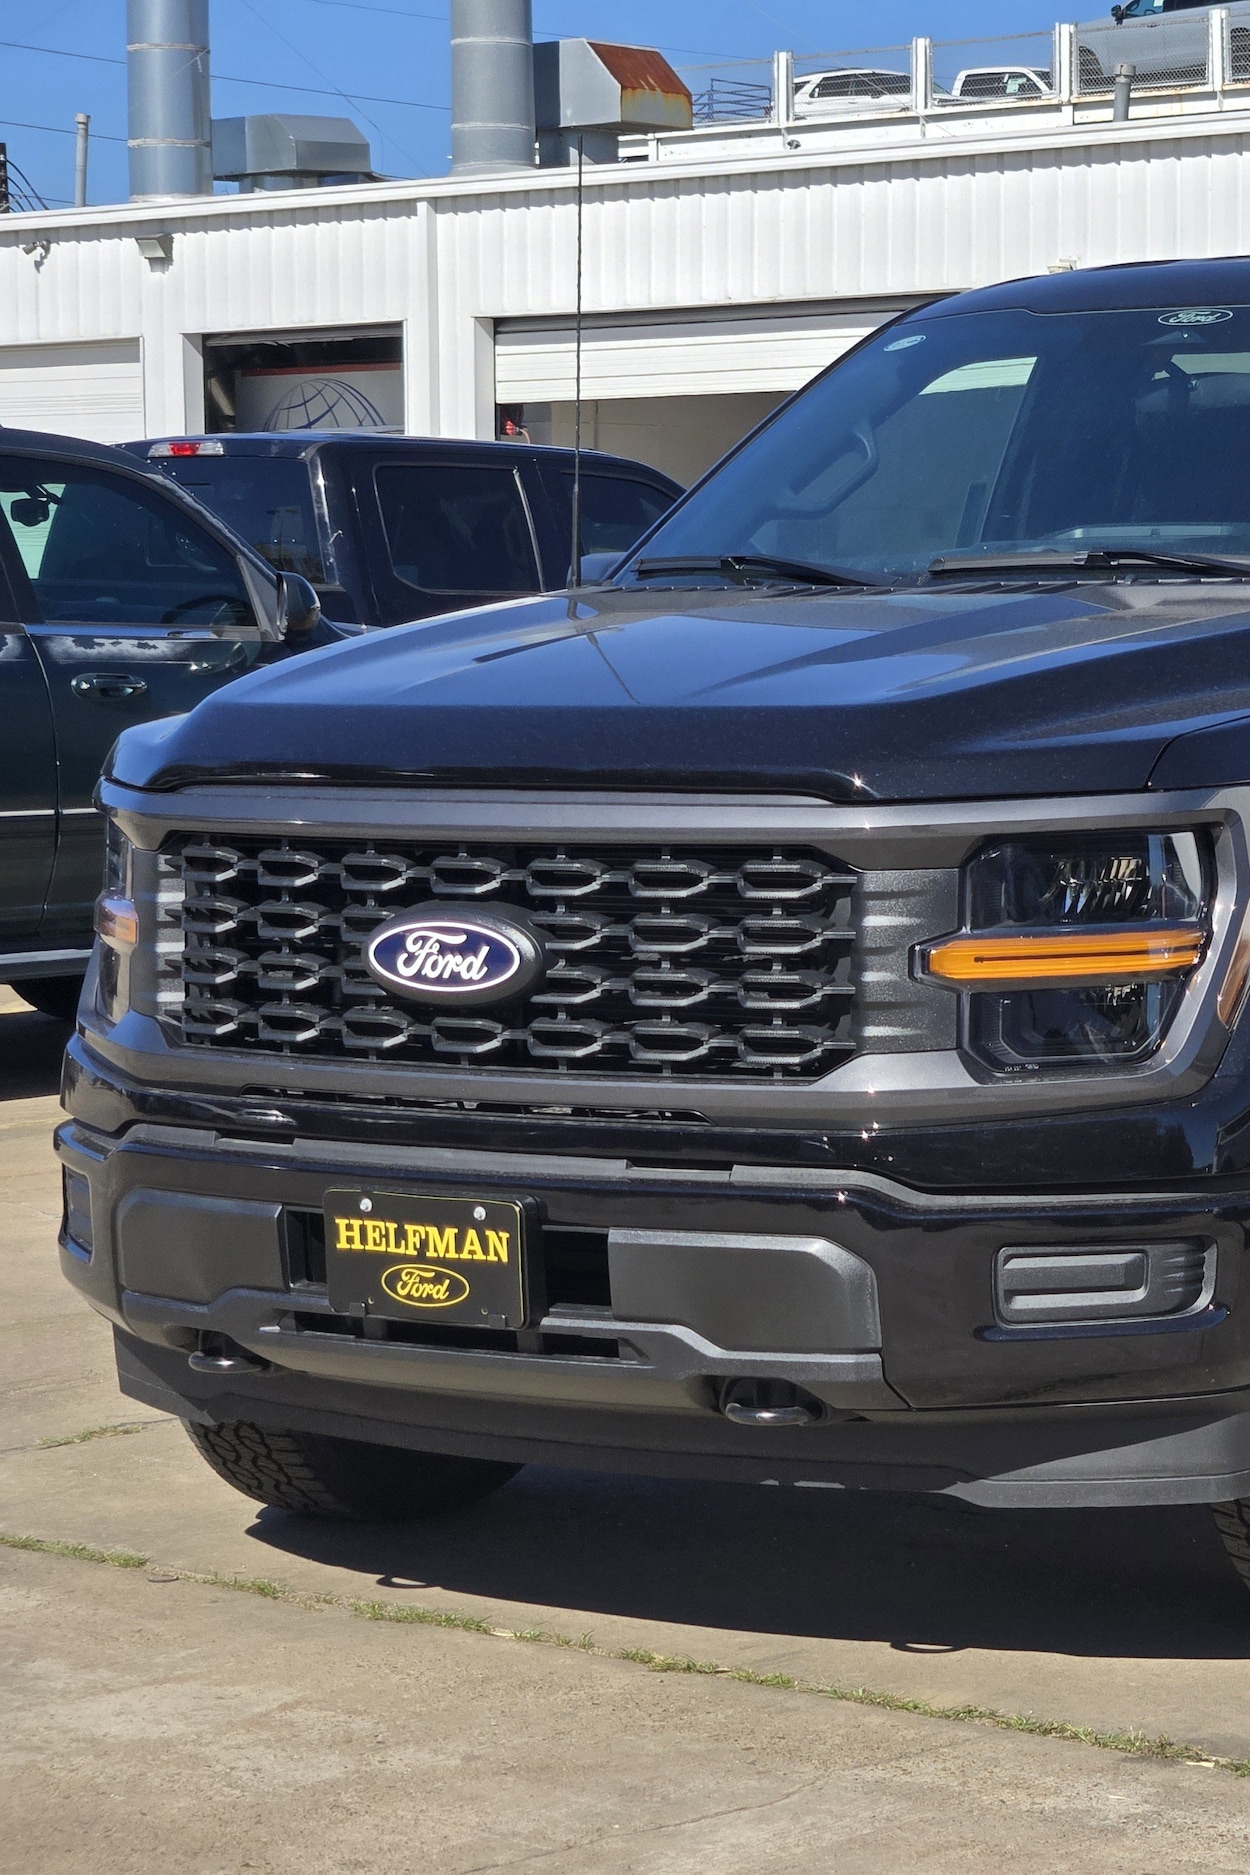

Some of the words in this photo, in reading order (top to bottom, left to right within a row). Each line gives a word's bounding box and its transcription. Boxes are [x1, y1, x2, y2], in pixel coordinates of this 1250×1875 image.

[1168, 311, 1222, 323] Ford
[397, 930, 491, 980] Ford
[335, 1218, 510, 1263] HELFMAN
[397, 1268, 450, 1300] Ford
